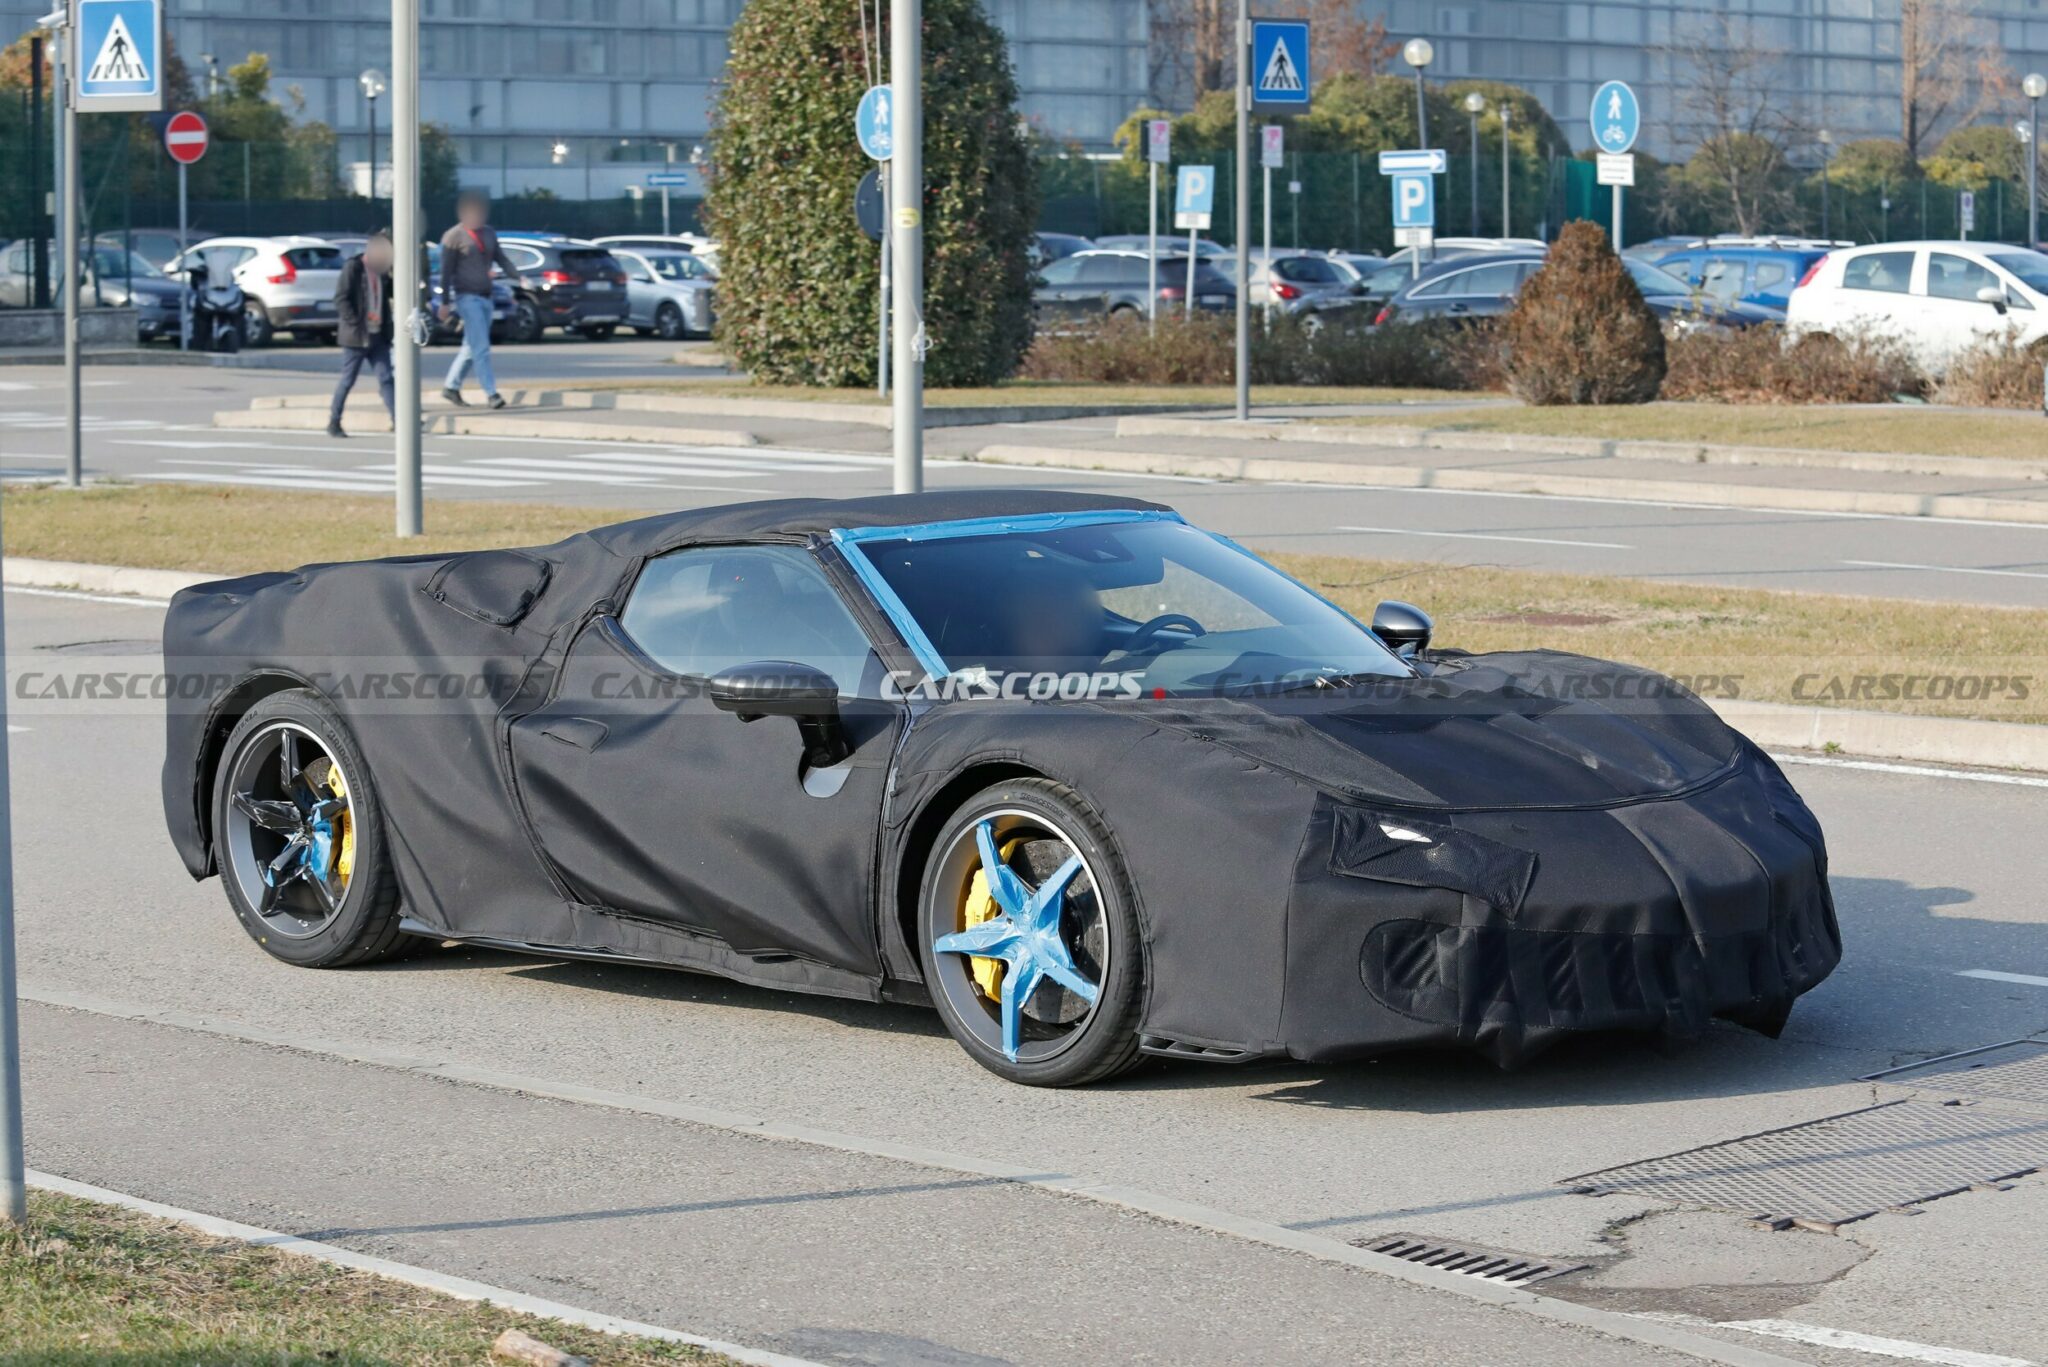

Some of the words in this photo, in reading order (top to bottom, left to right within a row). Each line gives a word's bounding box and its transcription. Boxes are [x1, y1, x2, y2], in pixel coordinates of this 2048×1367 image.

[1183, 171, 1206, 208] P
[1401, 179, 1425, 222] P
[326, 729, 364, 807] BRIDGESTONE
[1018, 791, 1069, 821] BRIDGESTONE
